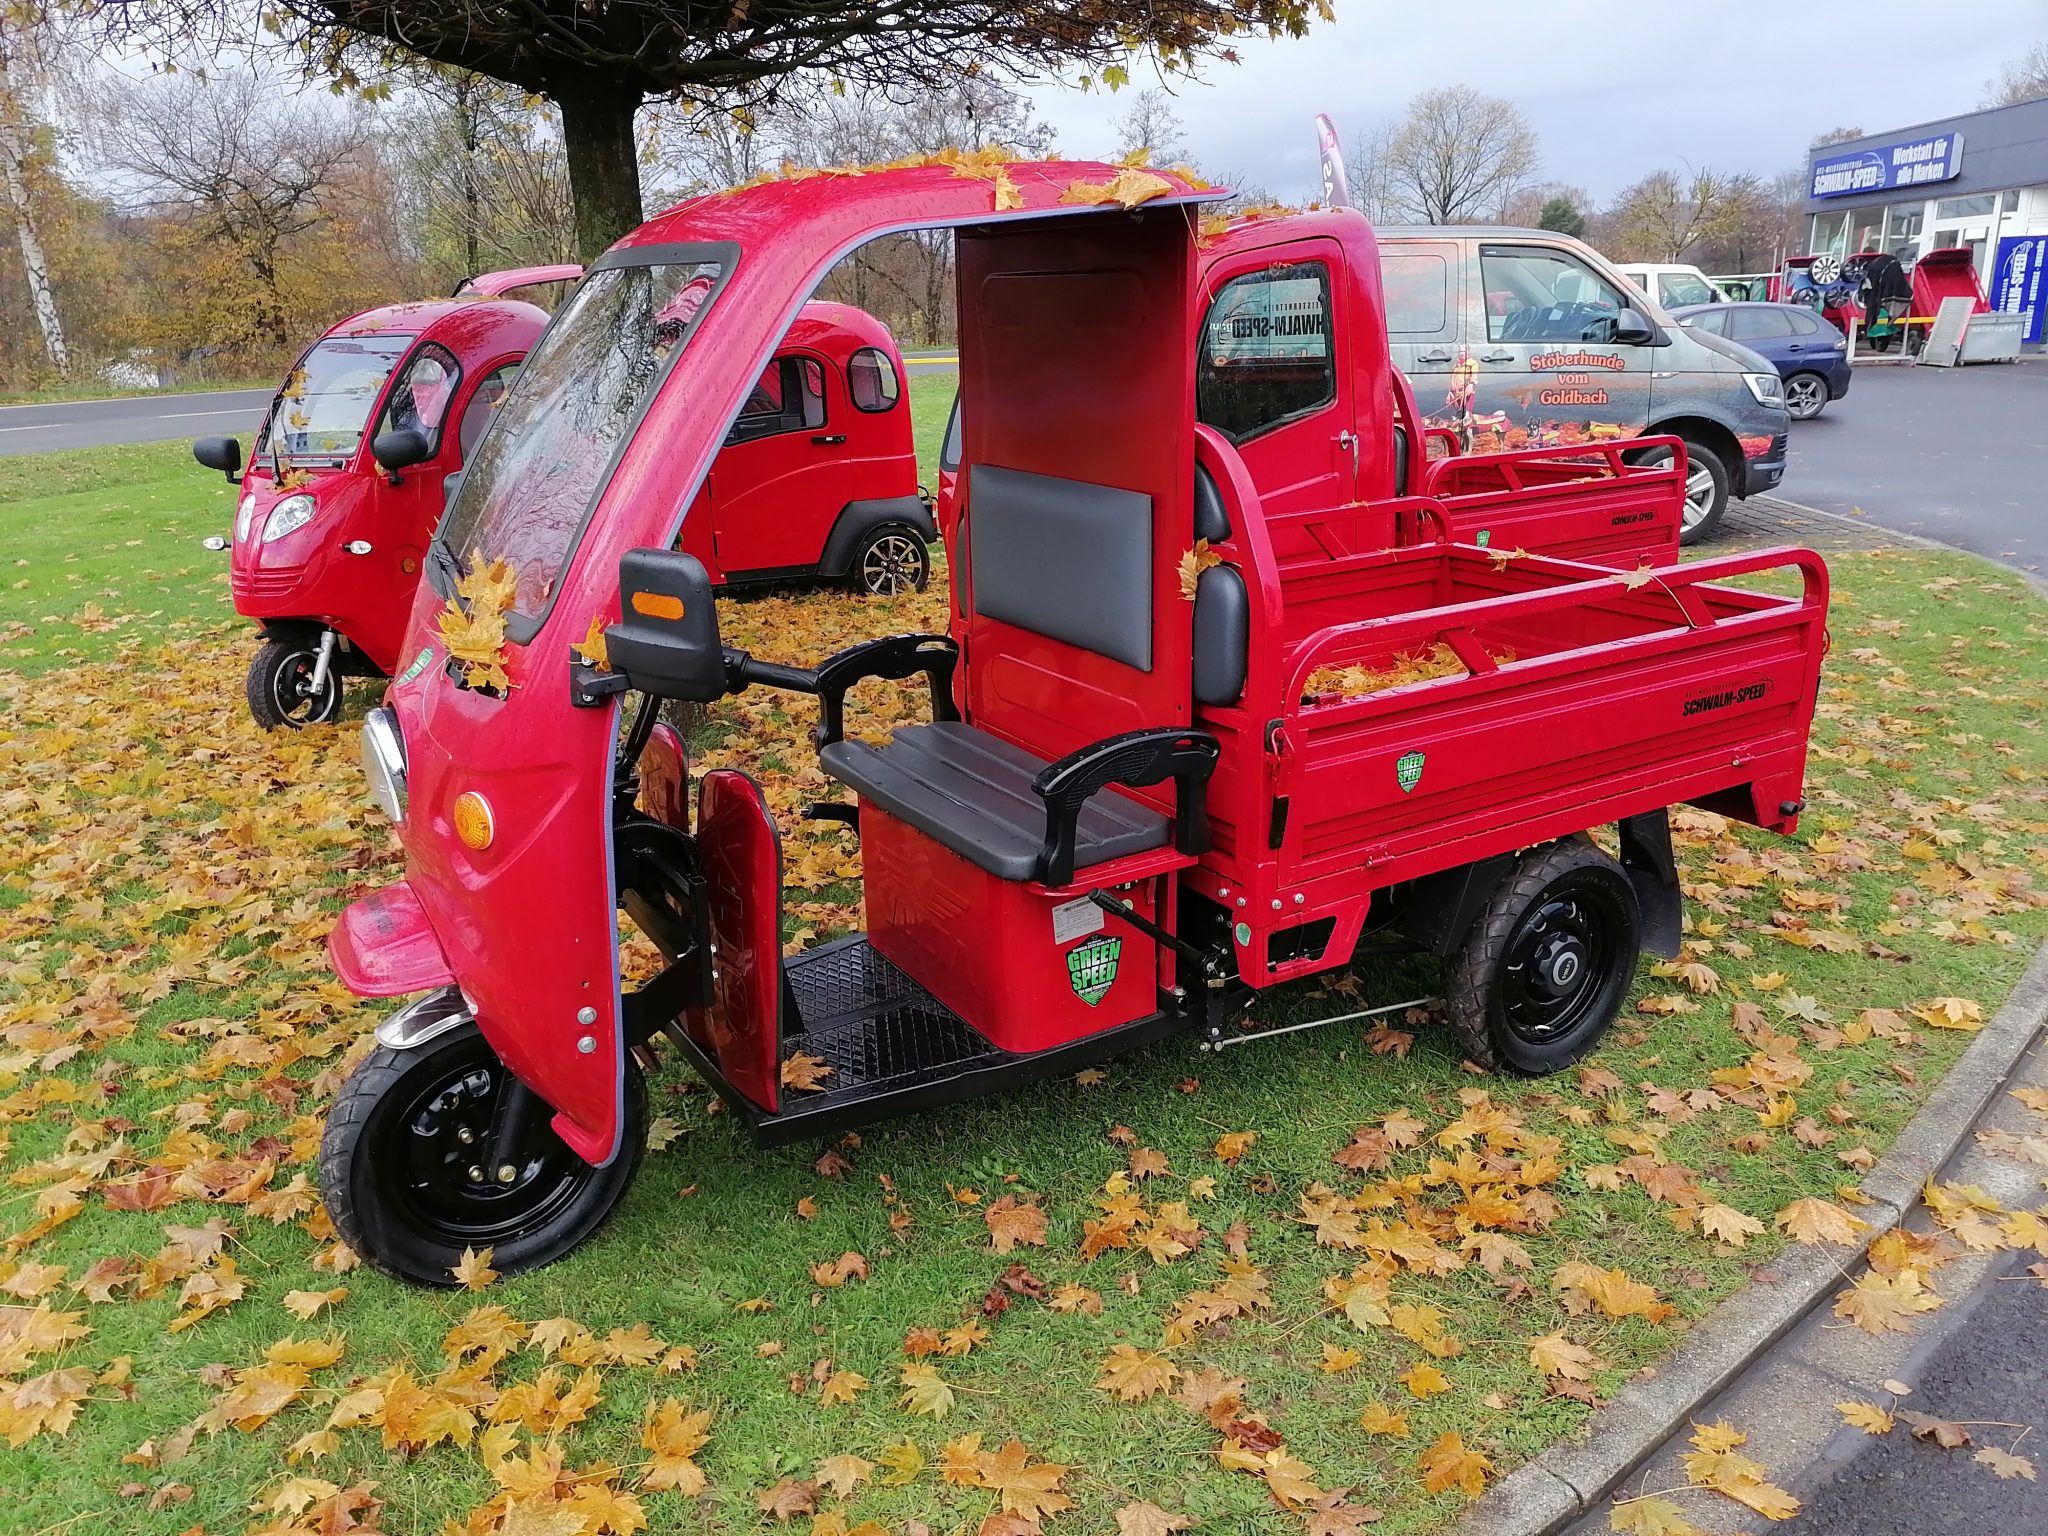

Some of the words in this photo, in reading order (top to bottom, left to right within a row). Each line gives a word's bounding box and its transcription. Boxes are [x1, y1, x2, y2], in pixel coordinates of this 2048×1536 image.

[1893, 144, 1932, 166] Werkstatt
[1933, 139, 1948, 158] für
[1814, 166, 1878, 195] SCHWALM-SPEED
[1896, 166, 1912, 185] alle
[1912, 162, 1944, 183] Marken
[1530, 349, 1625, 372] Stöberhunde
[1557, 373, 1589, 385] vom
[1539, 388, 1608, 406] Goldbach
[1611, 511, 1654, 526] SCHWALM-SPEED
[1682, 683, 1766, 717] SCHWALM-SPEED
[1397, 754, 1426, 771] GREEN
[1398, 768, 1423, 783] SPEED
[1067, 940, 1122, 972] GREEN
[1071, 961, 1118, 991] SPEED
